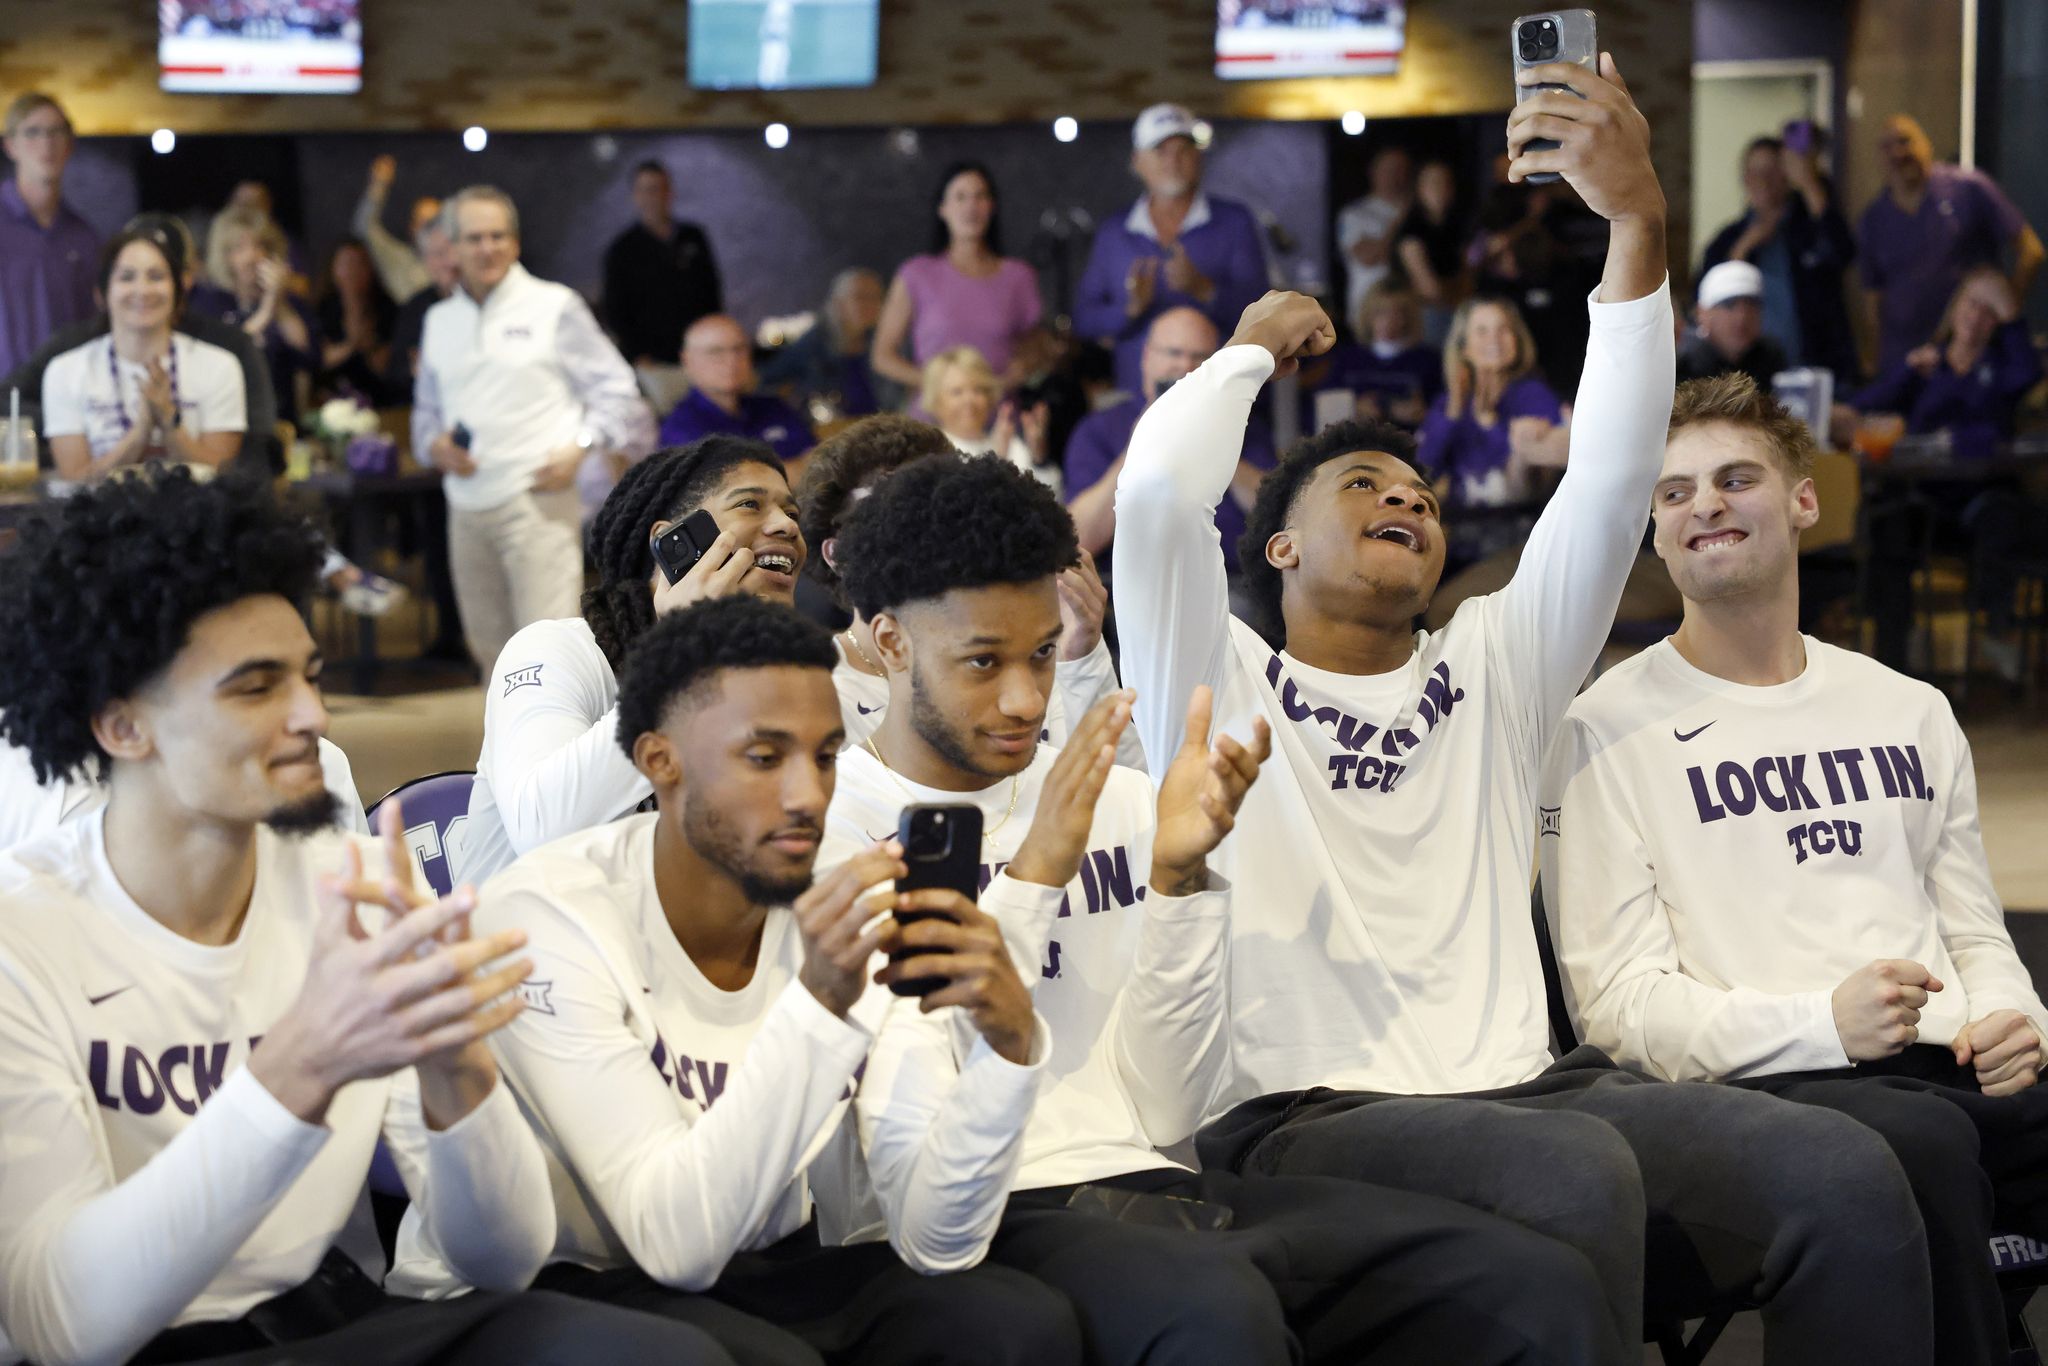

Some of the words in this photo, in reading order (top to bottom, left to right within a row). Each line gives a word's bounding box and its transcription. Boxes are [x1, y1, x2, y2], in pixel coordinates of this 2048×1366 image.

[1327, 754, 1407, 794] TCU
[1686, 753, 1822, 824] LOCK
[1817, 747, 1870, 806] IT
[1869, 745, 1935, 802] IN.
[1786, 819, 1863, 865] TCU
[90, 1040, 230, 1116] LOCK
